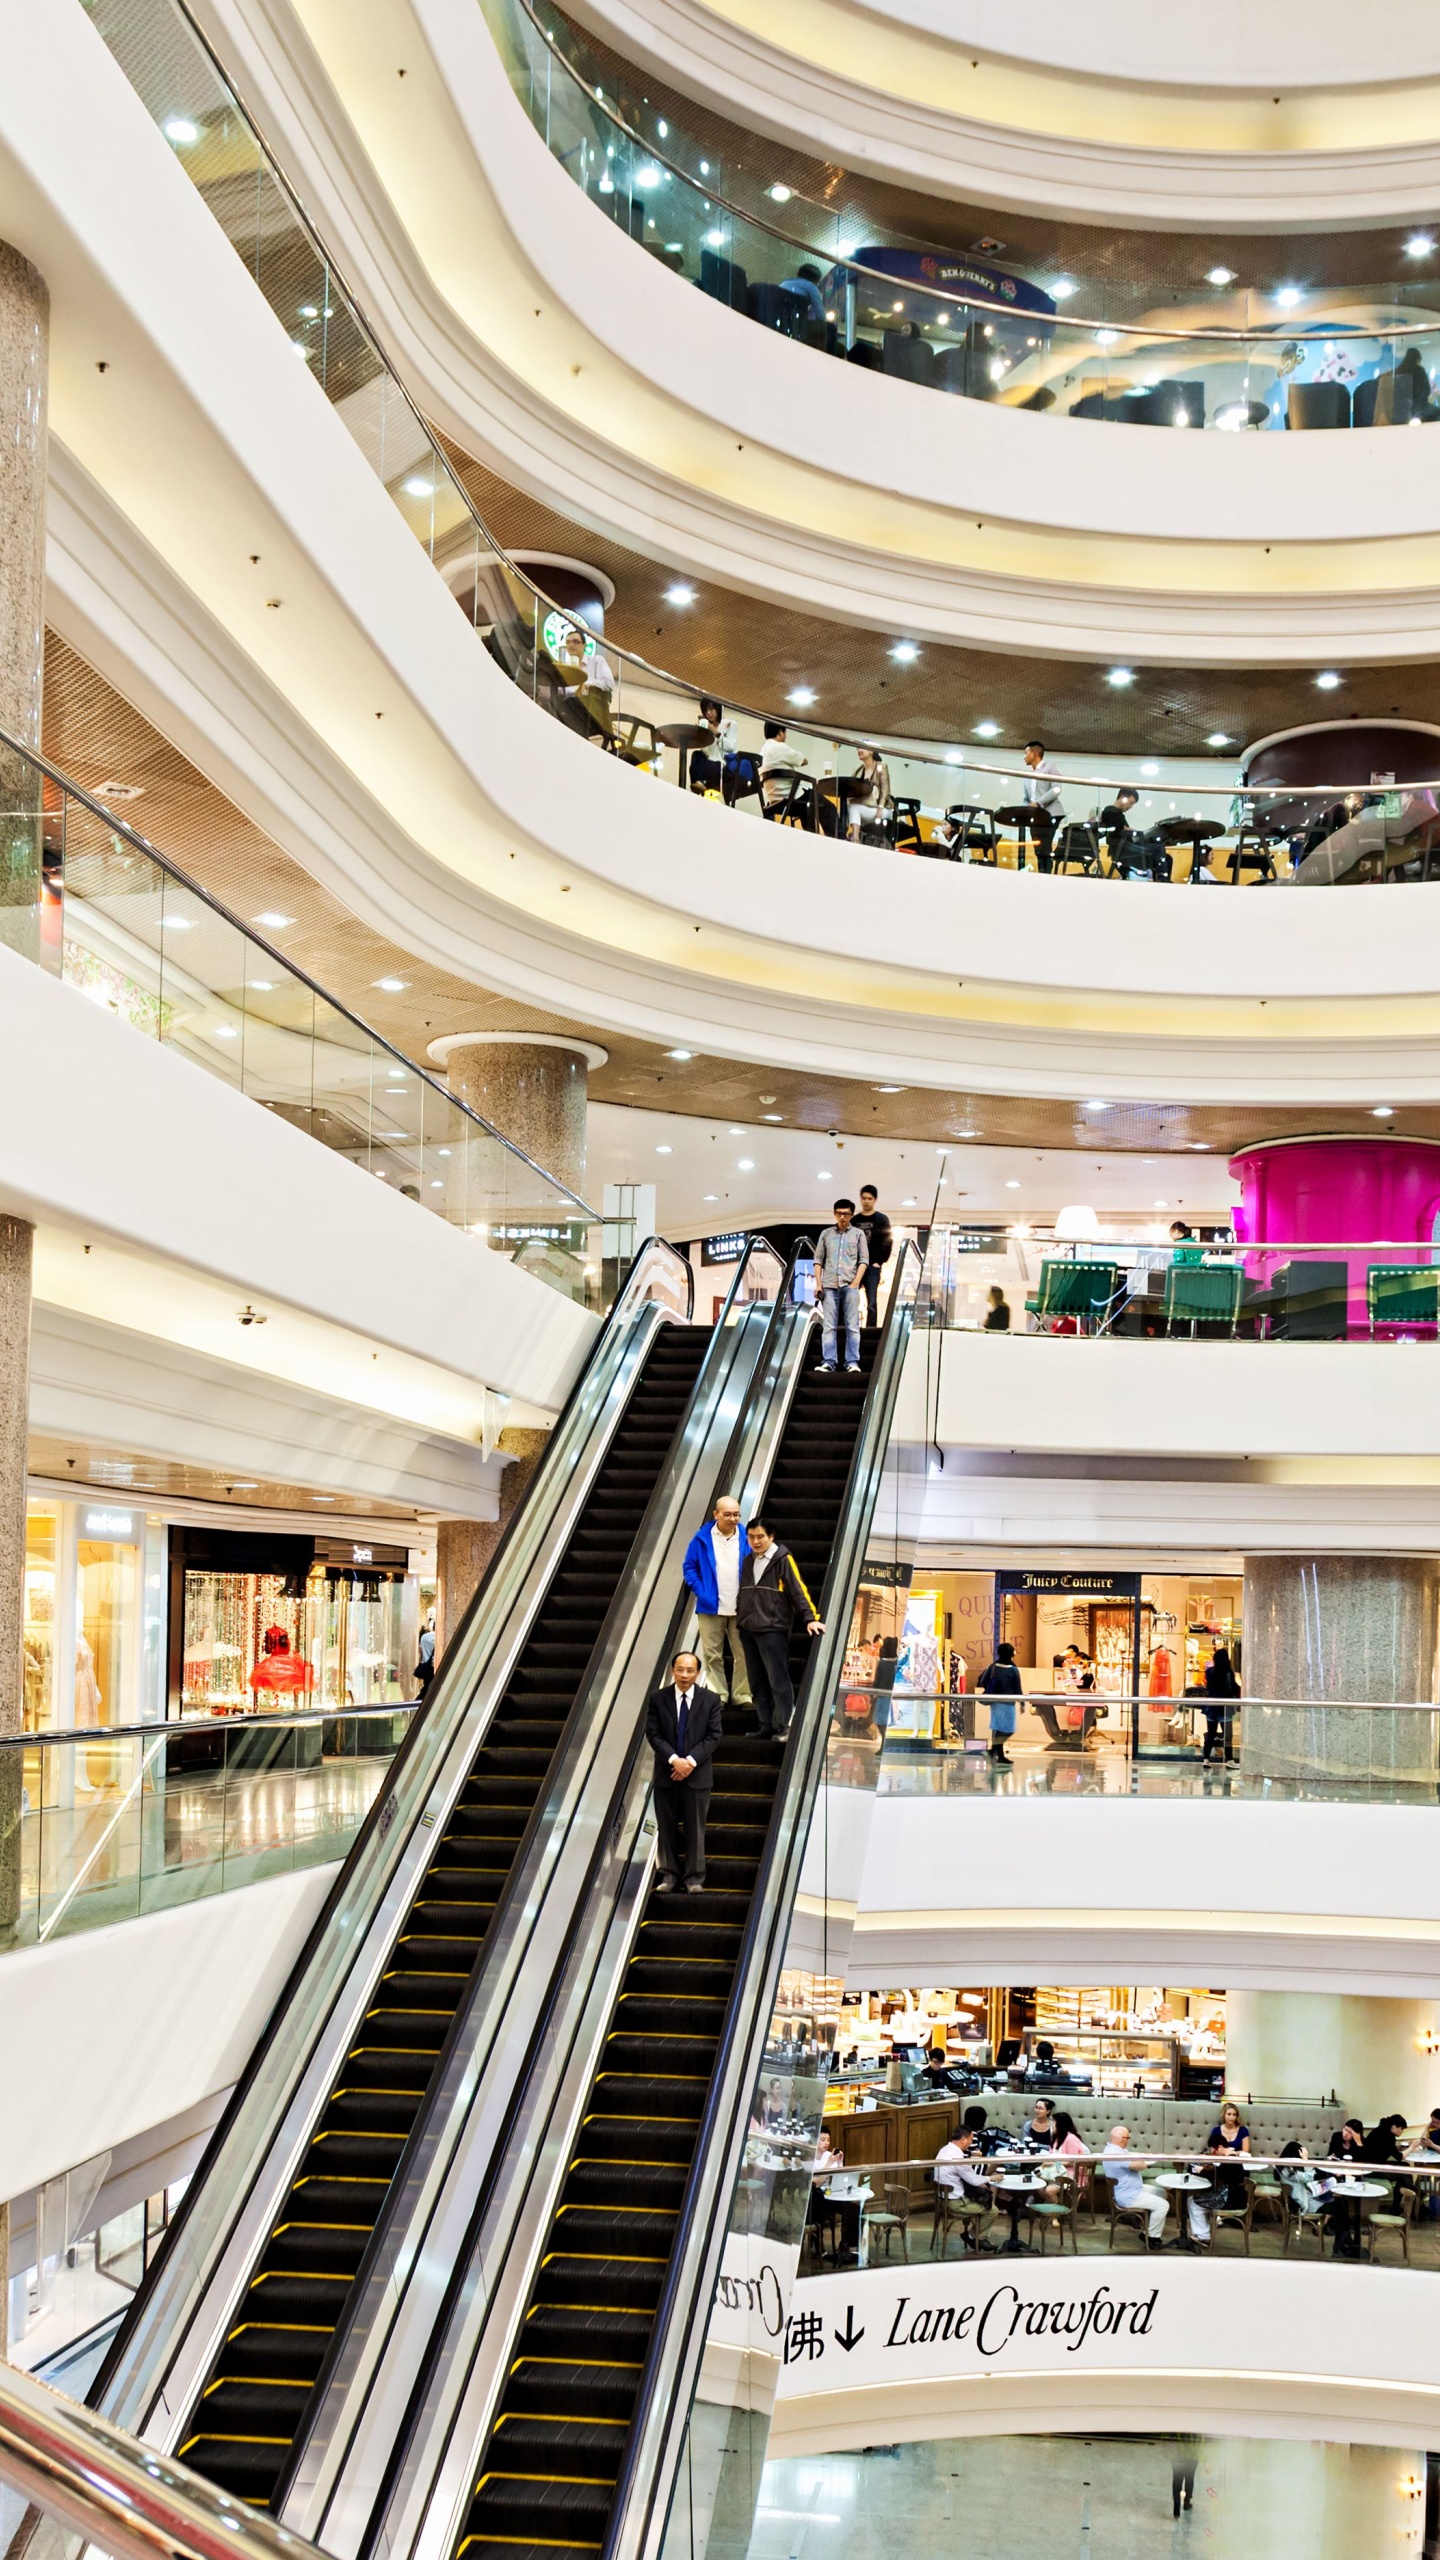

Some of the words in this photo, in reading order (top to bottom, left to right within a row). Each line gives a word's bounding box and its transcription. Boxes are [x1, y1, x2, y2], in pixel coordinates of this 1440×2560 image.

[708, 1239, 745, 1255] LINKS
[1022, 1573, 1058, 1589] Juicy
[1060, 1575, 1114, 1589] Couture
[883, 2297, 974, 2348] Lane
[976, 2285, 1159, 2356] Crawford
